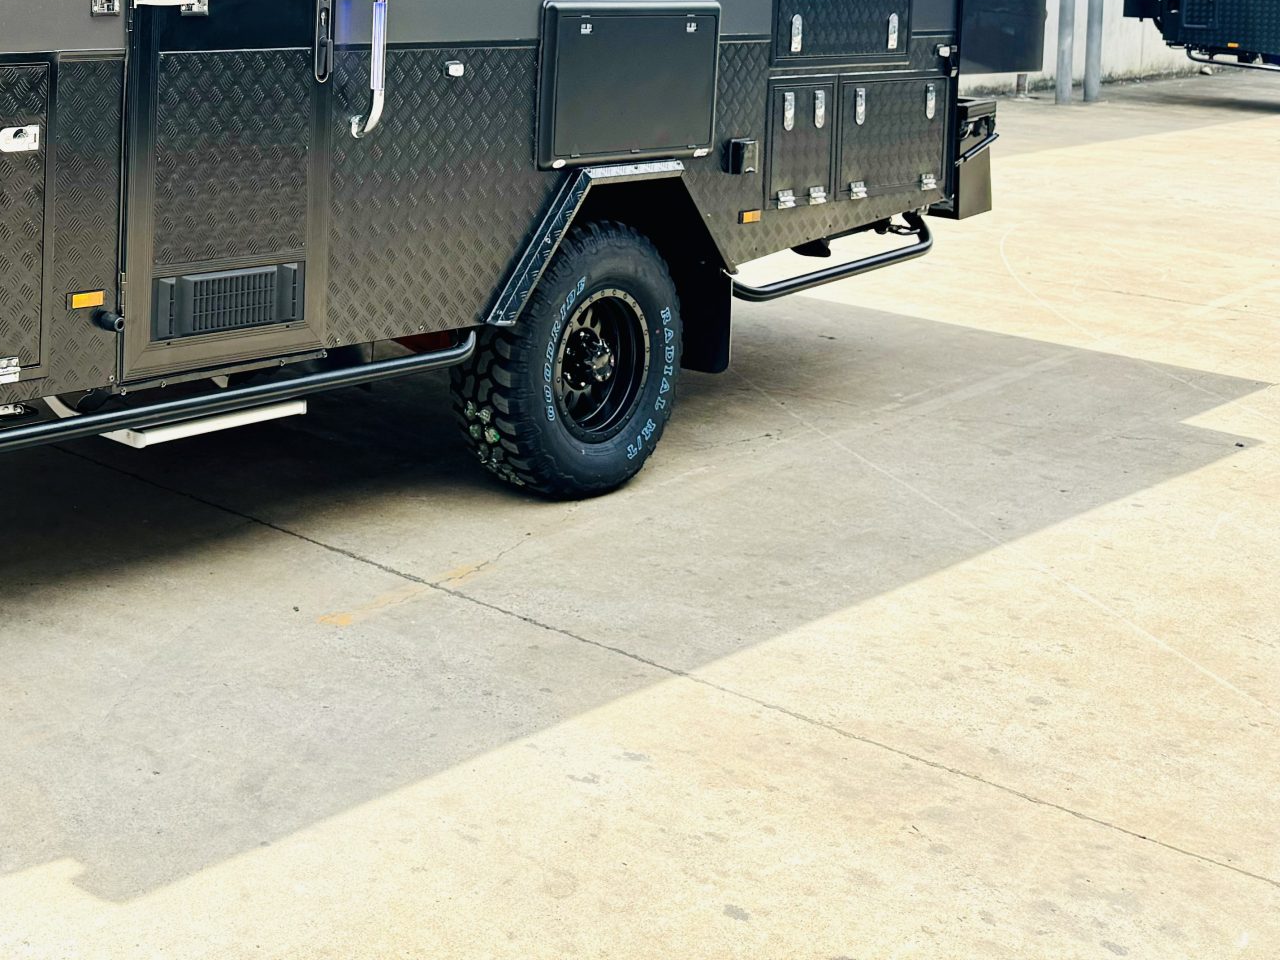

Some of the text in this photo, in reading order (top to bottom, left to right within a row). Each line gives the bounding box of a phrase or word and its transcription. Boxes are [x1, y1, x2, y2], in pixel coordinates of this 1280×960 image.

[544, 276, 586, 421] GOODRIDE
[627, 307, 675, 459] RADIAL M/T
